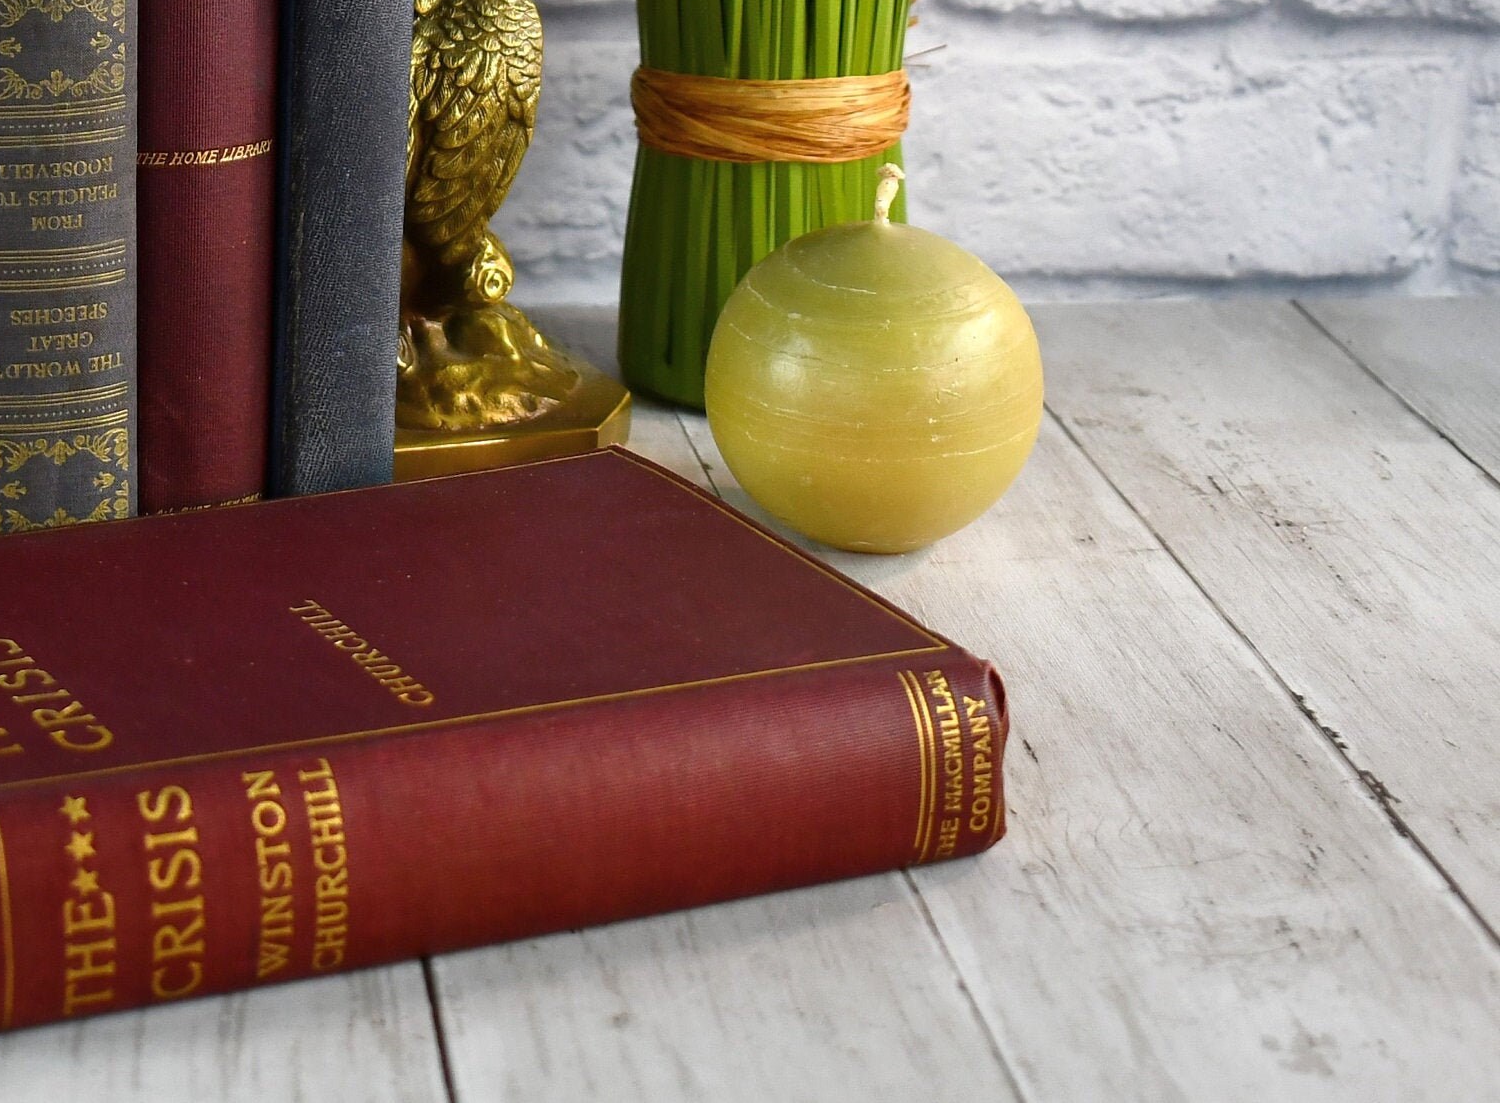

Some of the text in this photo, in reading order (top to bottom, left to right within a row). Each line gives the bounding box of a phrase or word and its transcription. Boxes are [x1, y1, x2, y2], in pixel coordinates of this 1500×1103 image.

[28, 183, 118, 206] PERICLES
[136, 138, 273, 165] THE HOME LIBRARY
[31, 214, 83, 231] FROM
[10, 302, 108, 326] SPEECHES
[26, 331, 94, 352] GREAT
[87, 352, 124, 375] THE
[289, 598, 434, 707] CHURCHILL
[924, 670, 963, 857] THE MACMILLAN
[963, 696, 993, 832] COMPANY
[137, 785, 205, 997] CRISIS
[241, 770, 295, 979] WINSTON
[298, 757, 349, 972] CHURCHILL
[63, 891, 116, 1014] THE
